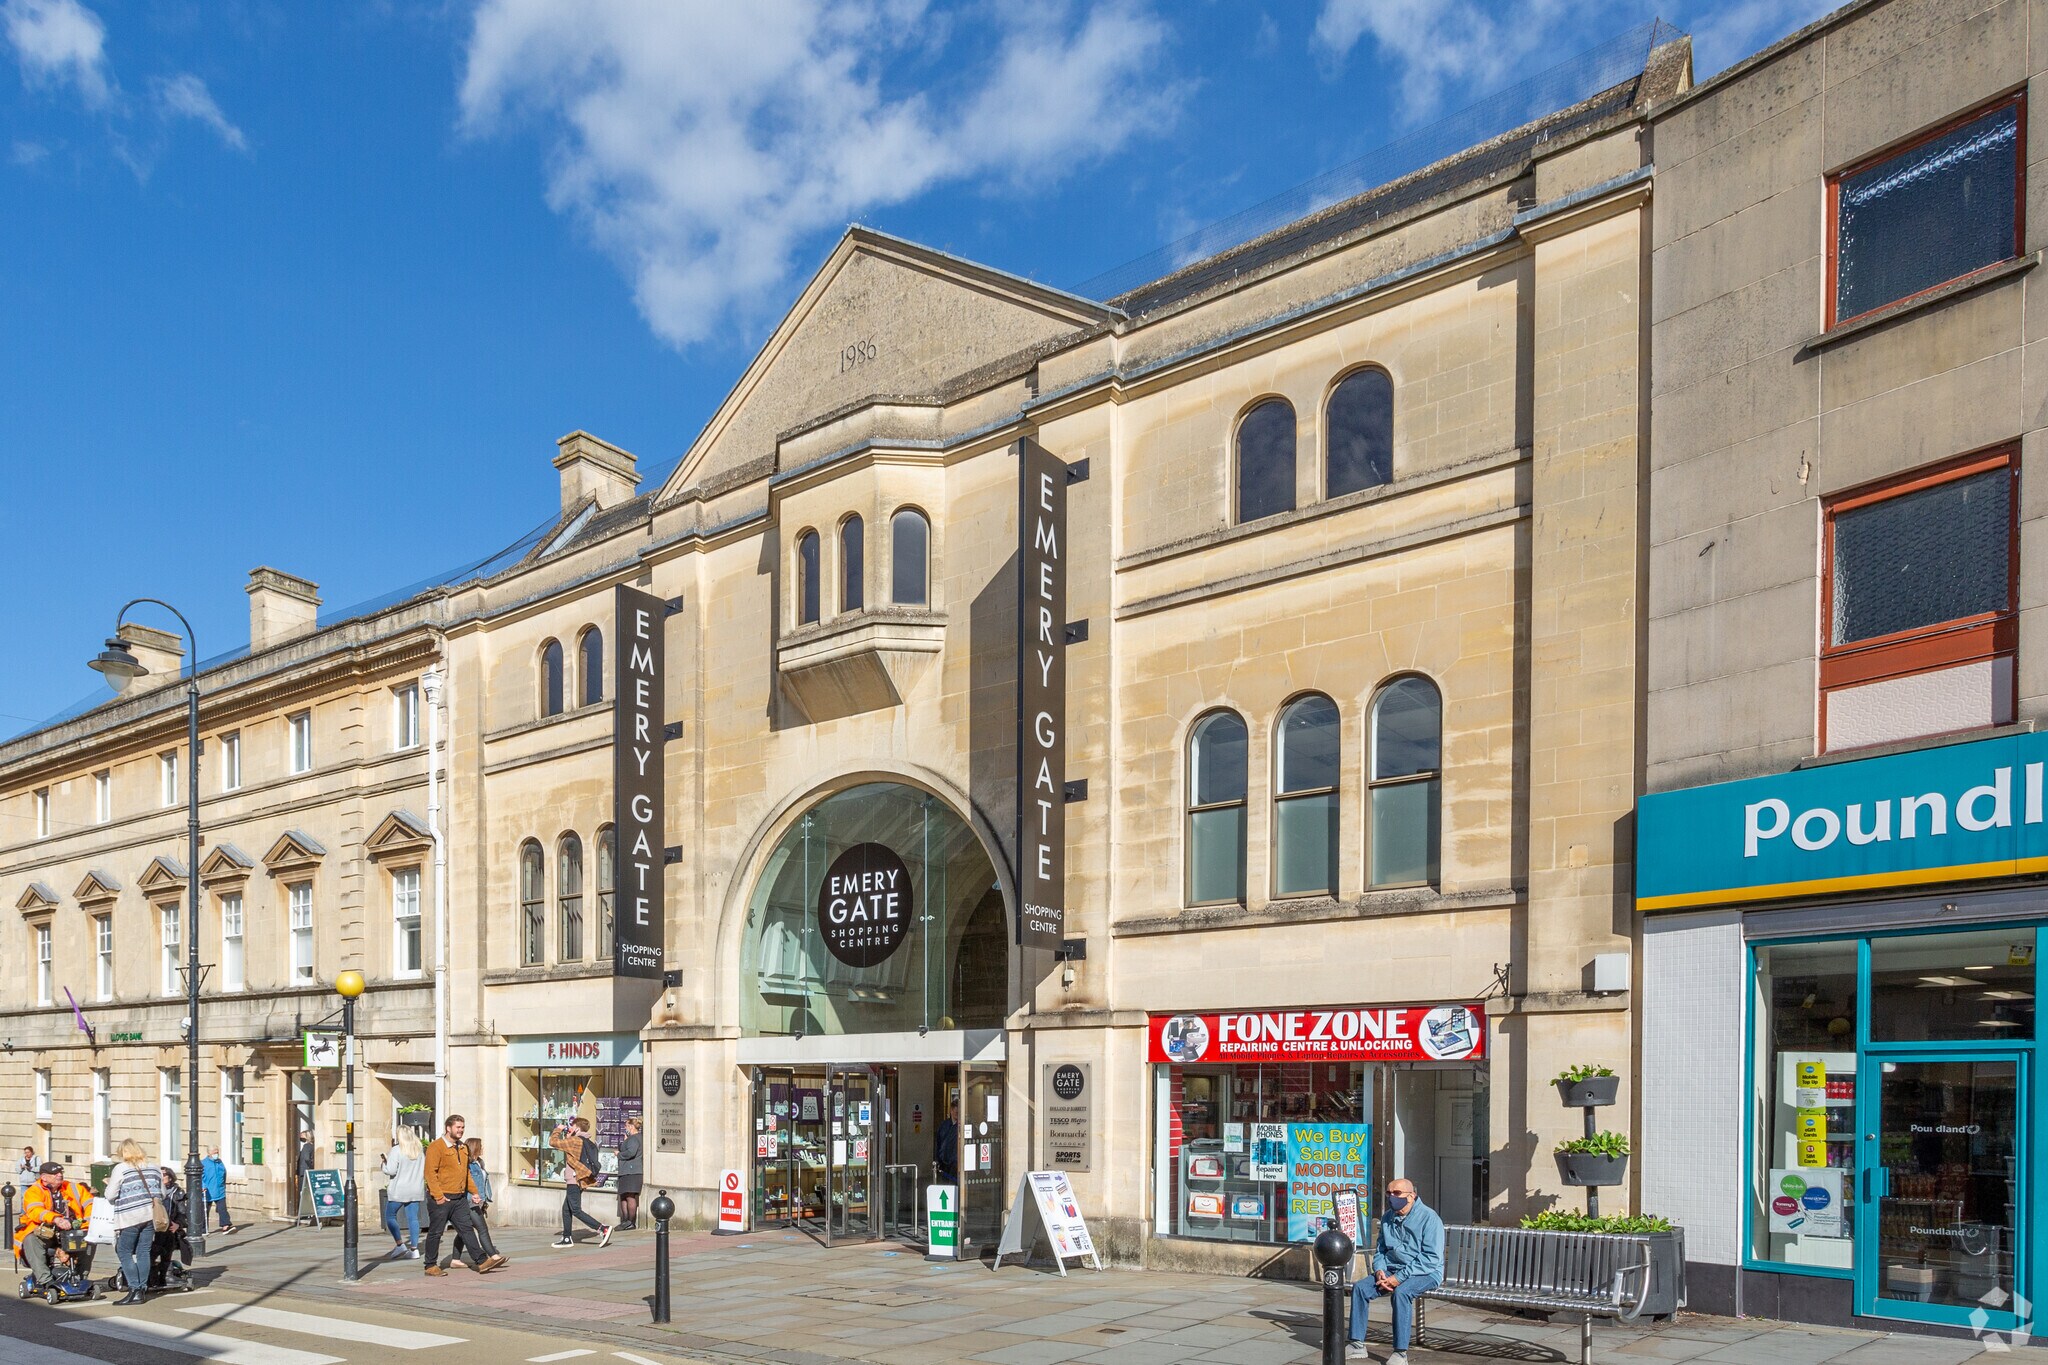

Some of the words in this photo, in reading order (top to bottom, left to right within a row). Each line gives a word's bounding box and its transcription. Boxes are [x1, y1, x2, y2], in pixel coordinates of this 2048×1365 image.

[841, 332, 878, 373] 1986
[1035, 472, 1057, 688] EMERY
[630, 609, 654, 776] EMERY
[1035, 711, 1055, 881] GATE
[631, 794, 653, 926] GATE
[831, 869, 899, 896] EMERY
[829, 892, 899, 924] GATE
[1024, 903, 1062, 920] SHOPPING
[831, 924, 899, 938] SHOPPING
[1030, 920, 1057, 934] CENTRE
[622, 944, 662, 956] SHOPPING
[840, 936, 889, 948] CENTRE
[627, 956, 657, 967] CENTRE
[1219, 1012, 1306, 1042] FONE
[1308, 1009, 1409, 1040] ZONE
[111, 1033, 128, 1041] LLOYDS
[130, 1032, 143, 1041] BANK
[560, 1042, 600, 1059] HINDS
[1220, 1042, 1278, 1052] REPAIRING
[1282, 1041, 1328, 1051] CENTRE
[1330, 1041, 1339, 1051] &
[1340, 1039, 1413, 1051] UNLOCKING
[1056, 1079, 1080, 1087] GATE
[1050, 1130, 1086, 1138] Bonmarché
[1295, 1129, 1324, 1143] We
[1329, 1129, 1366, 1147] Buy
[1300, 1146, 1341, 1161] Sale
[1346, 1147, 1361, 1162] &
[1295, 1162, 1365, 1178] MOBILE
[1292, 1199, 1368, 1216] REPR
[938, 1230, 953, 1238] ONLY
[1910, 1226, 1965, 1236] Poundland
